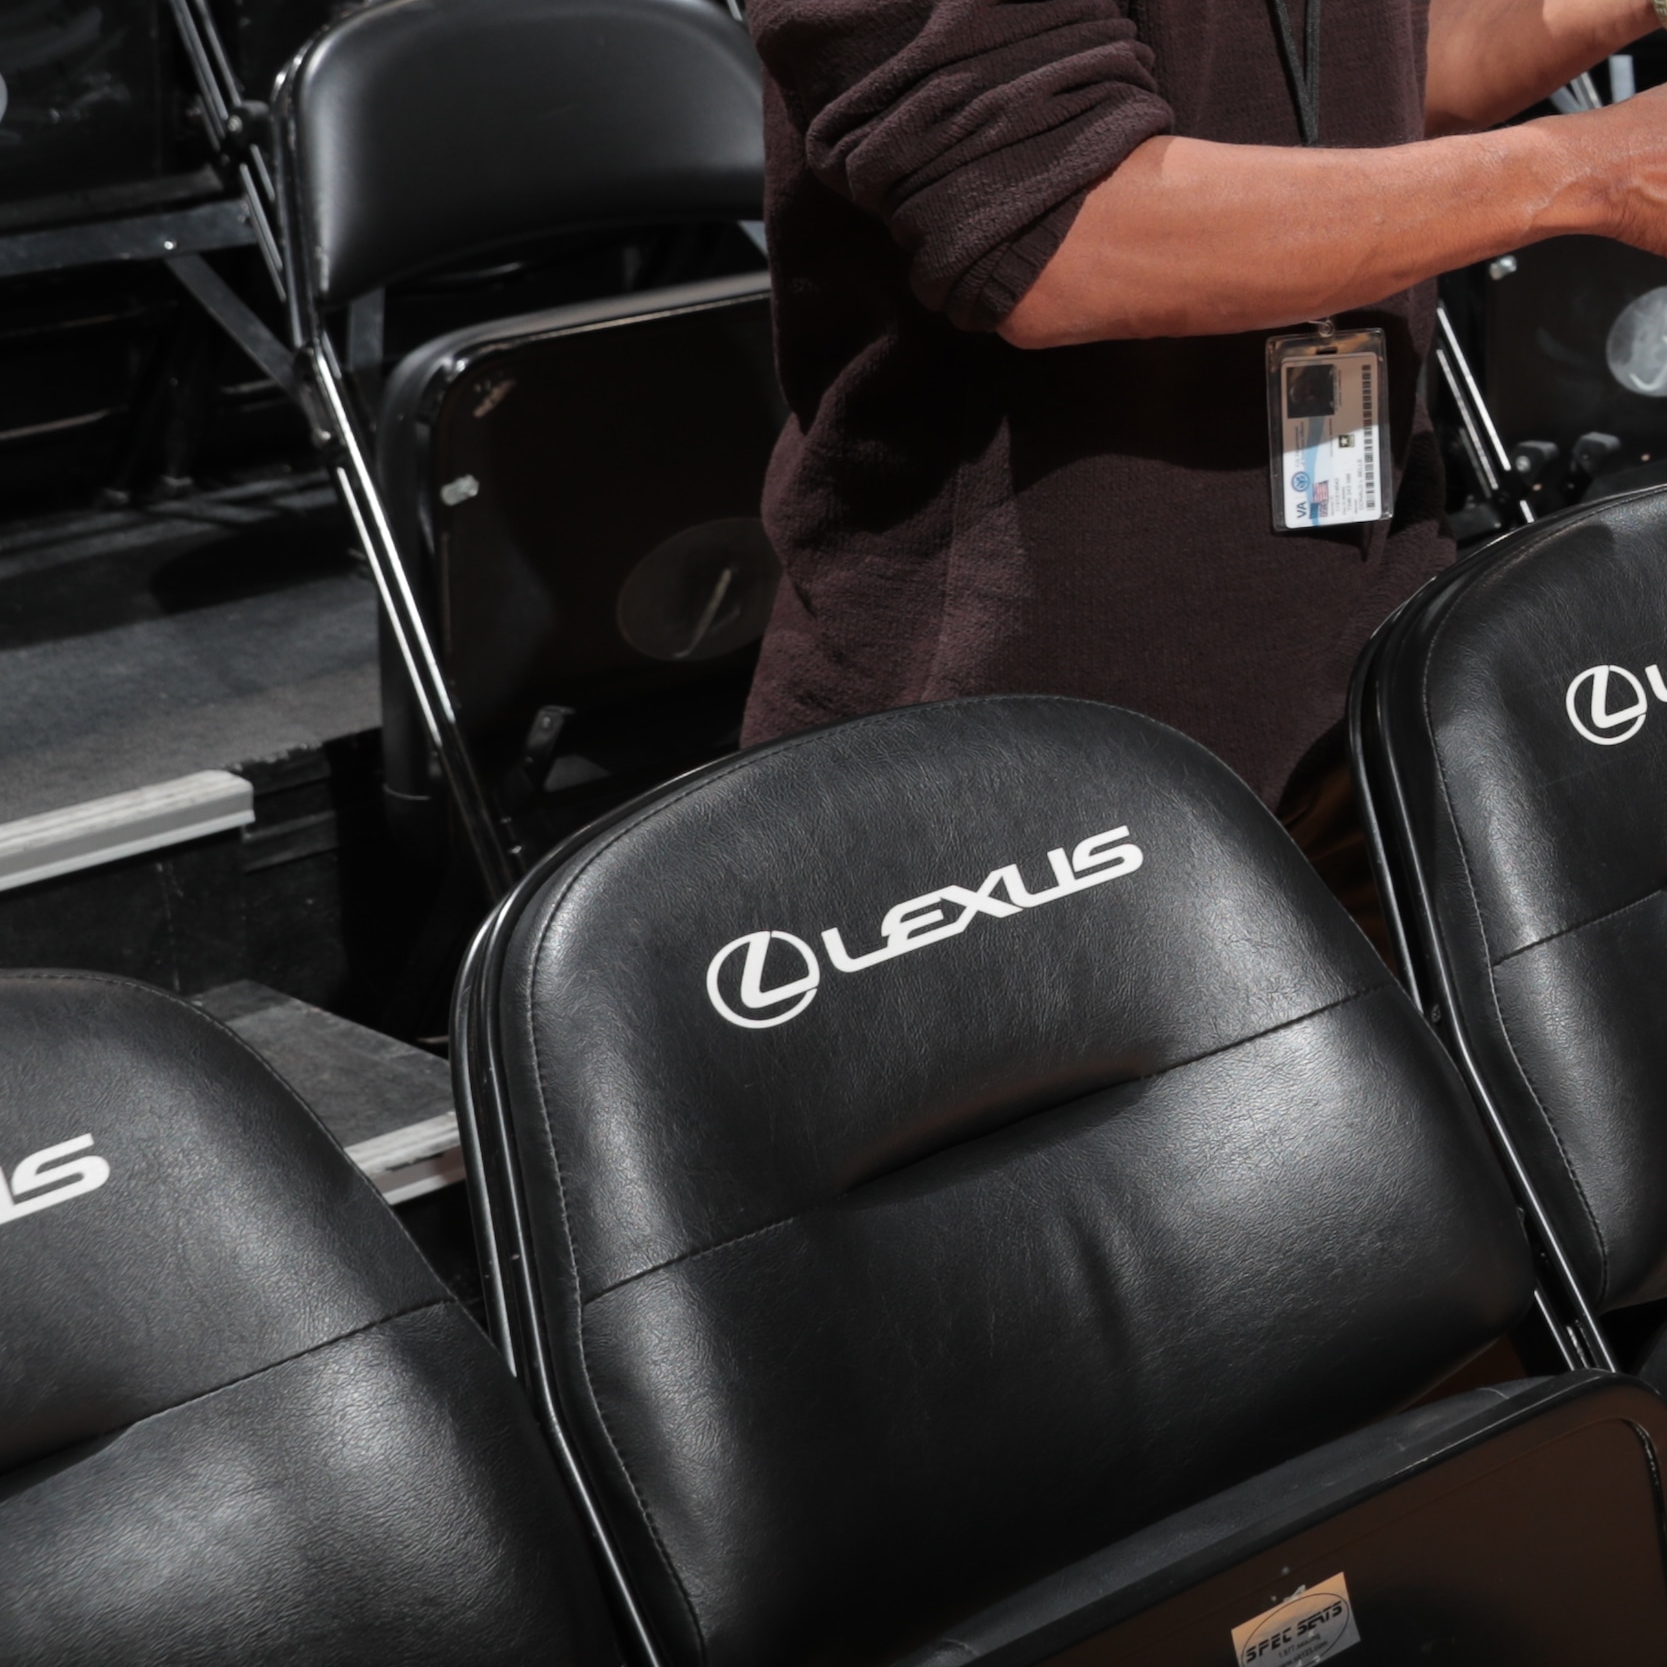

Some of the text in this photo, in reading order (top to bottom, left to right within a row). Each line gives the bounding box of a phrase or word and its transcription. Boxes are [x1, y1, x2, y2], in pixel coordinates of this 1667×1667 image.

[821, 825, 1144, 973] LEXUS
[1245, 1599, 1343, 1664] SPEC SEATS
